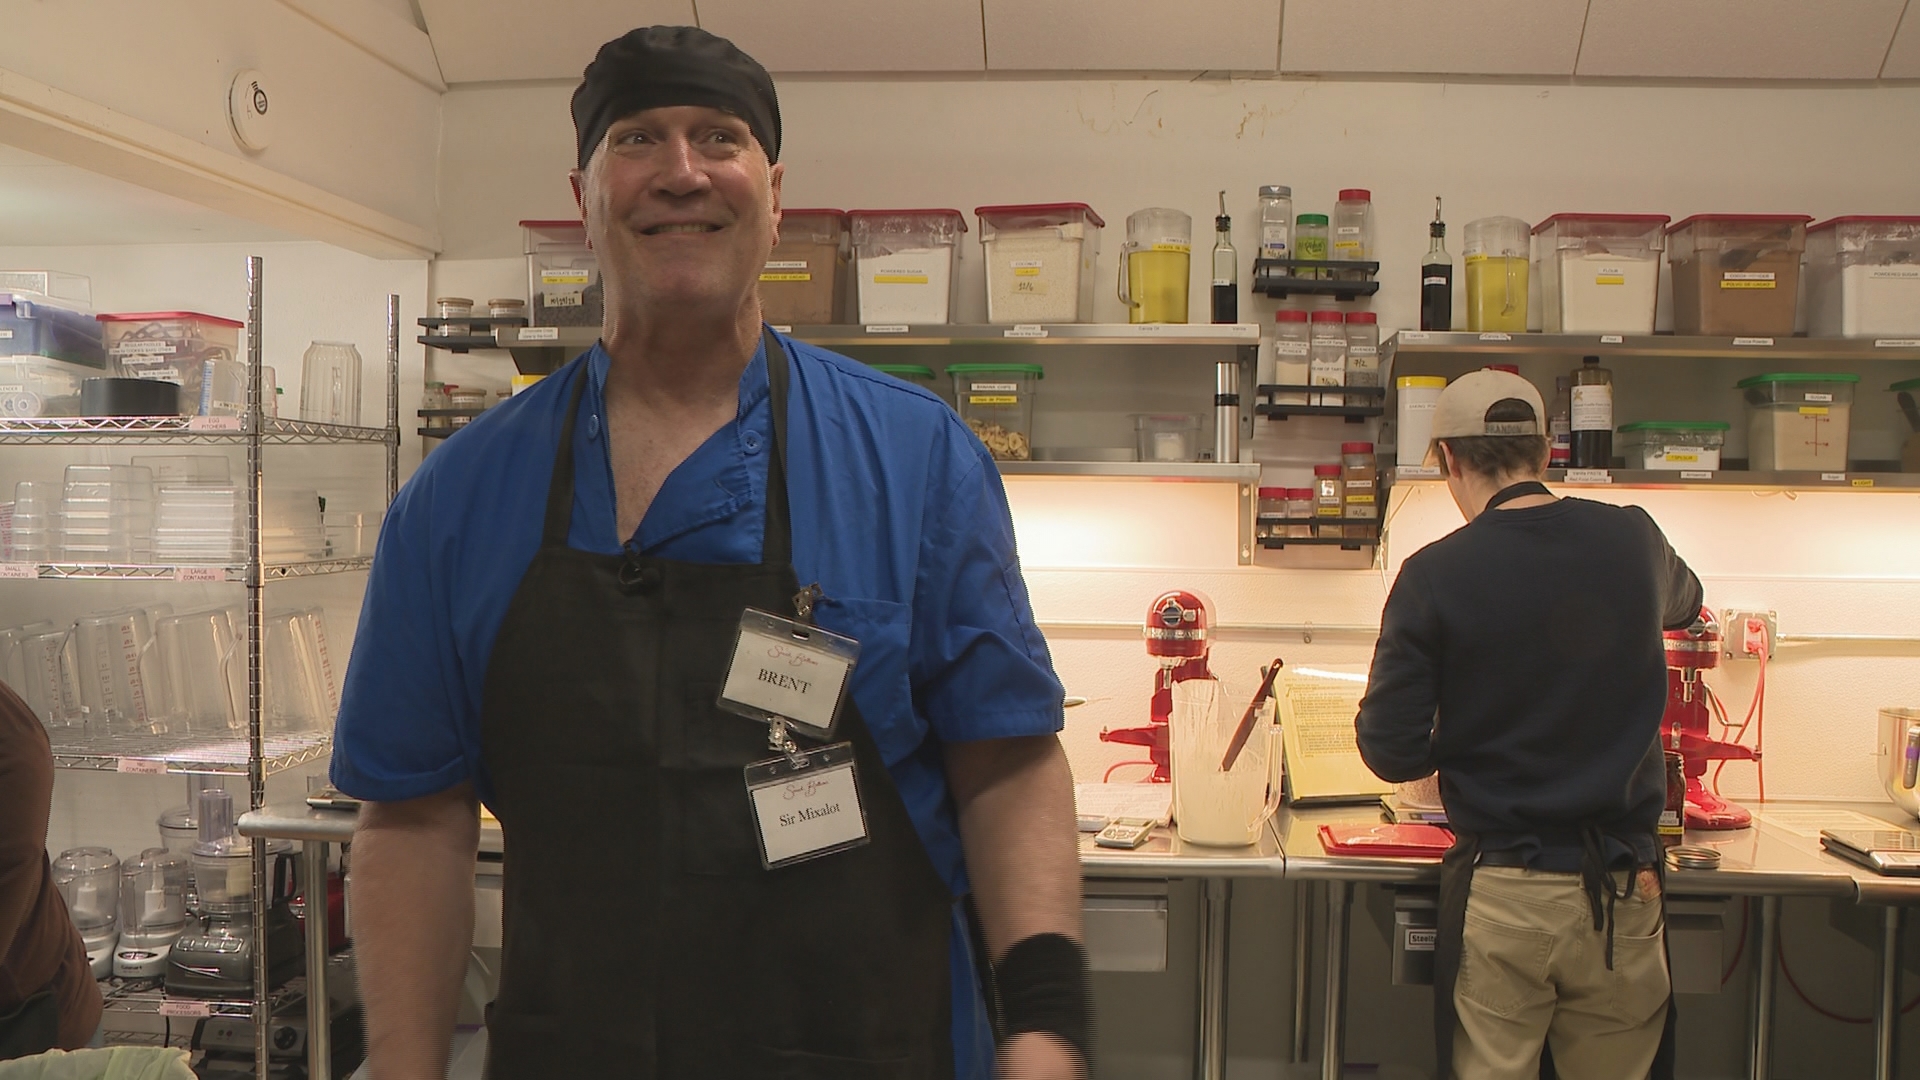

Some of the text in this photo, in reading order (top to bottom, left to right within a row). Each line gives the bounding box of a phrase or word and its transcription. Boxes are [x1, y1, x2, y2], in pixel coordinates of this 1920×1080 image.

[758, 668, 812, 694] BRENT
[779, 802, 841, 827] Sir Mixalot
